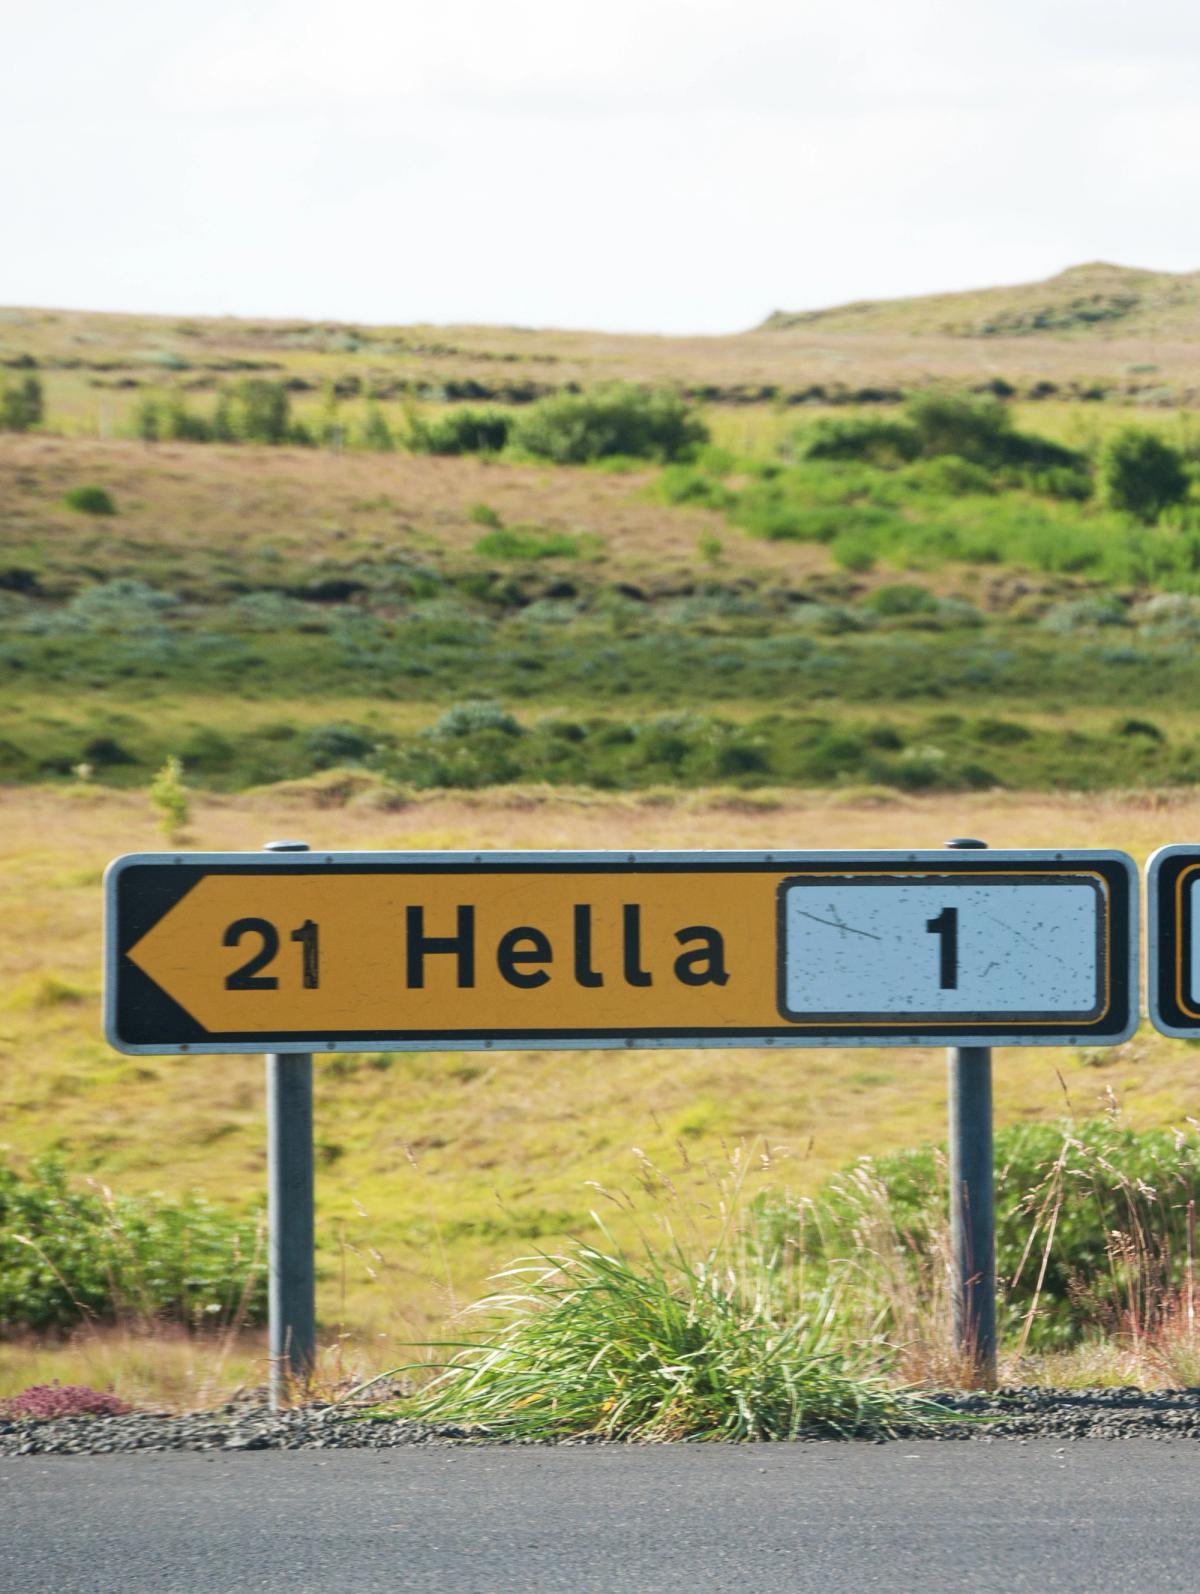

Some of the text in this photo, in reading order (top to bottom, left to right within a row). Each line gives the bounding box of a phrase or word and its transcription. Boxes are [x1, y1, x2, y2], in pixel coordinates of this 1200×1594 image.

[222, 903, 959, 991] 21 Hella 1
